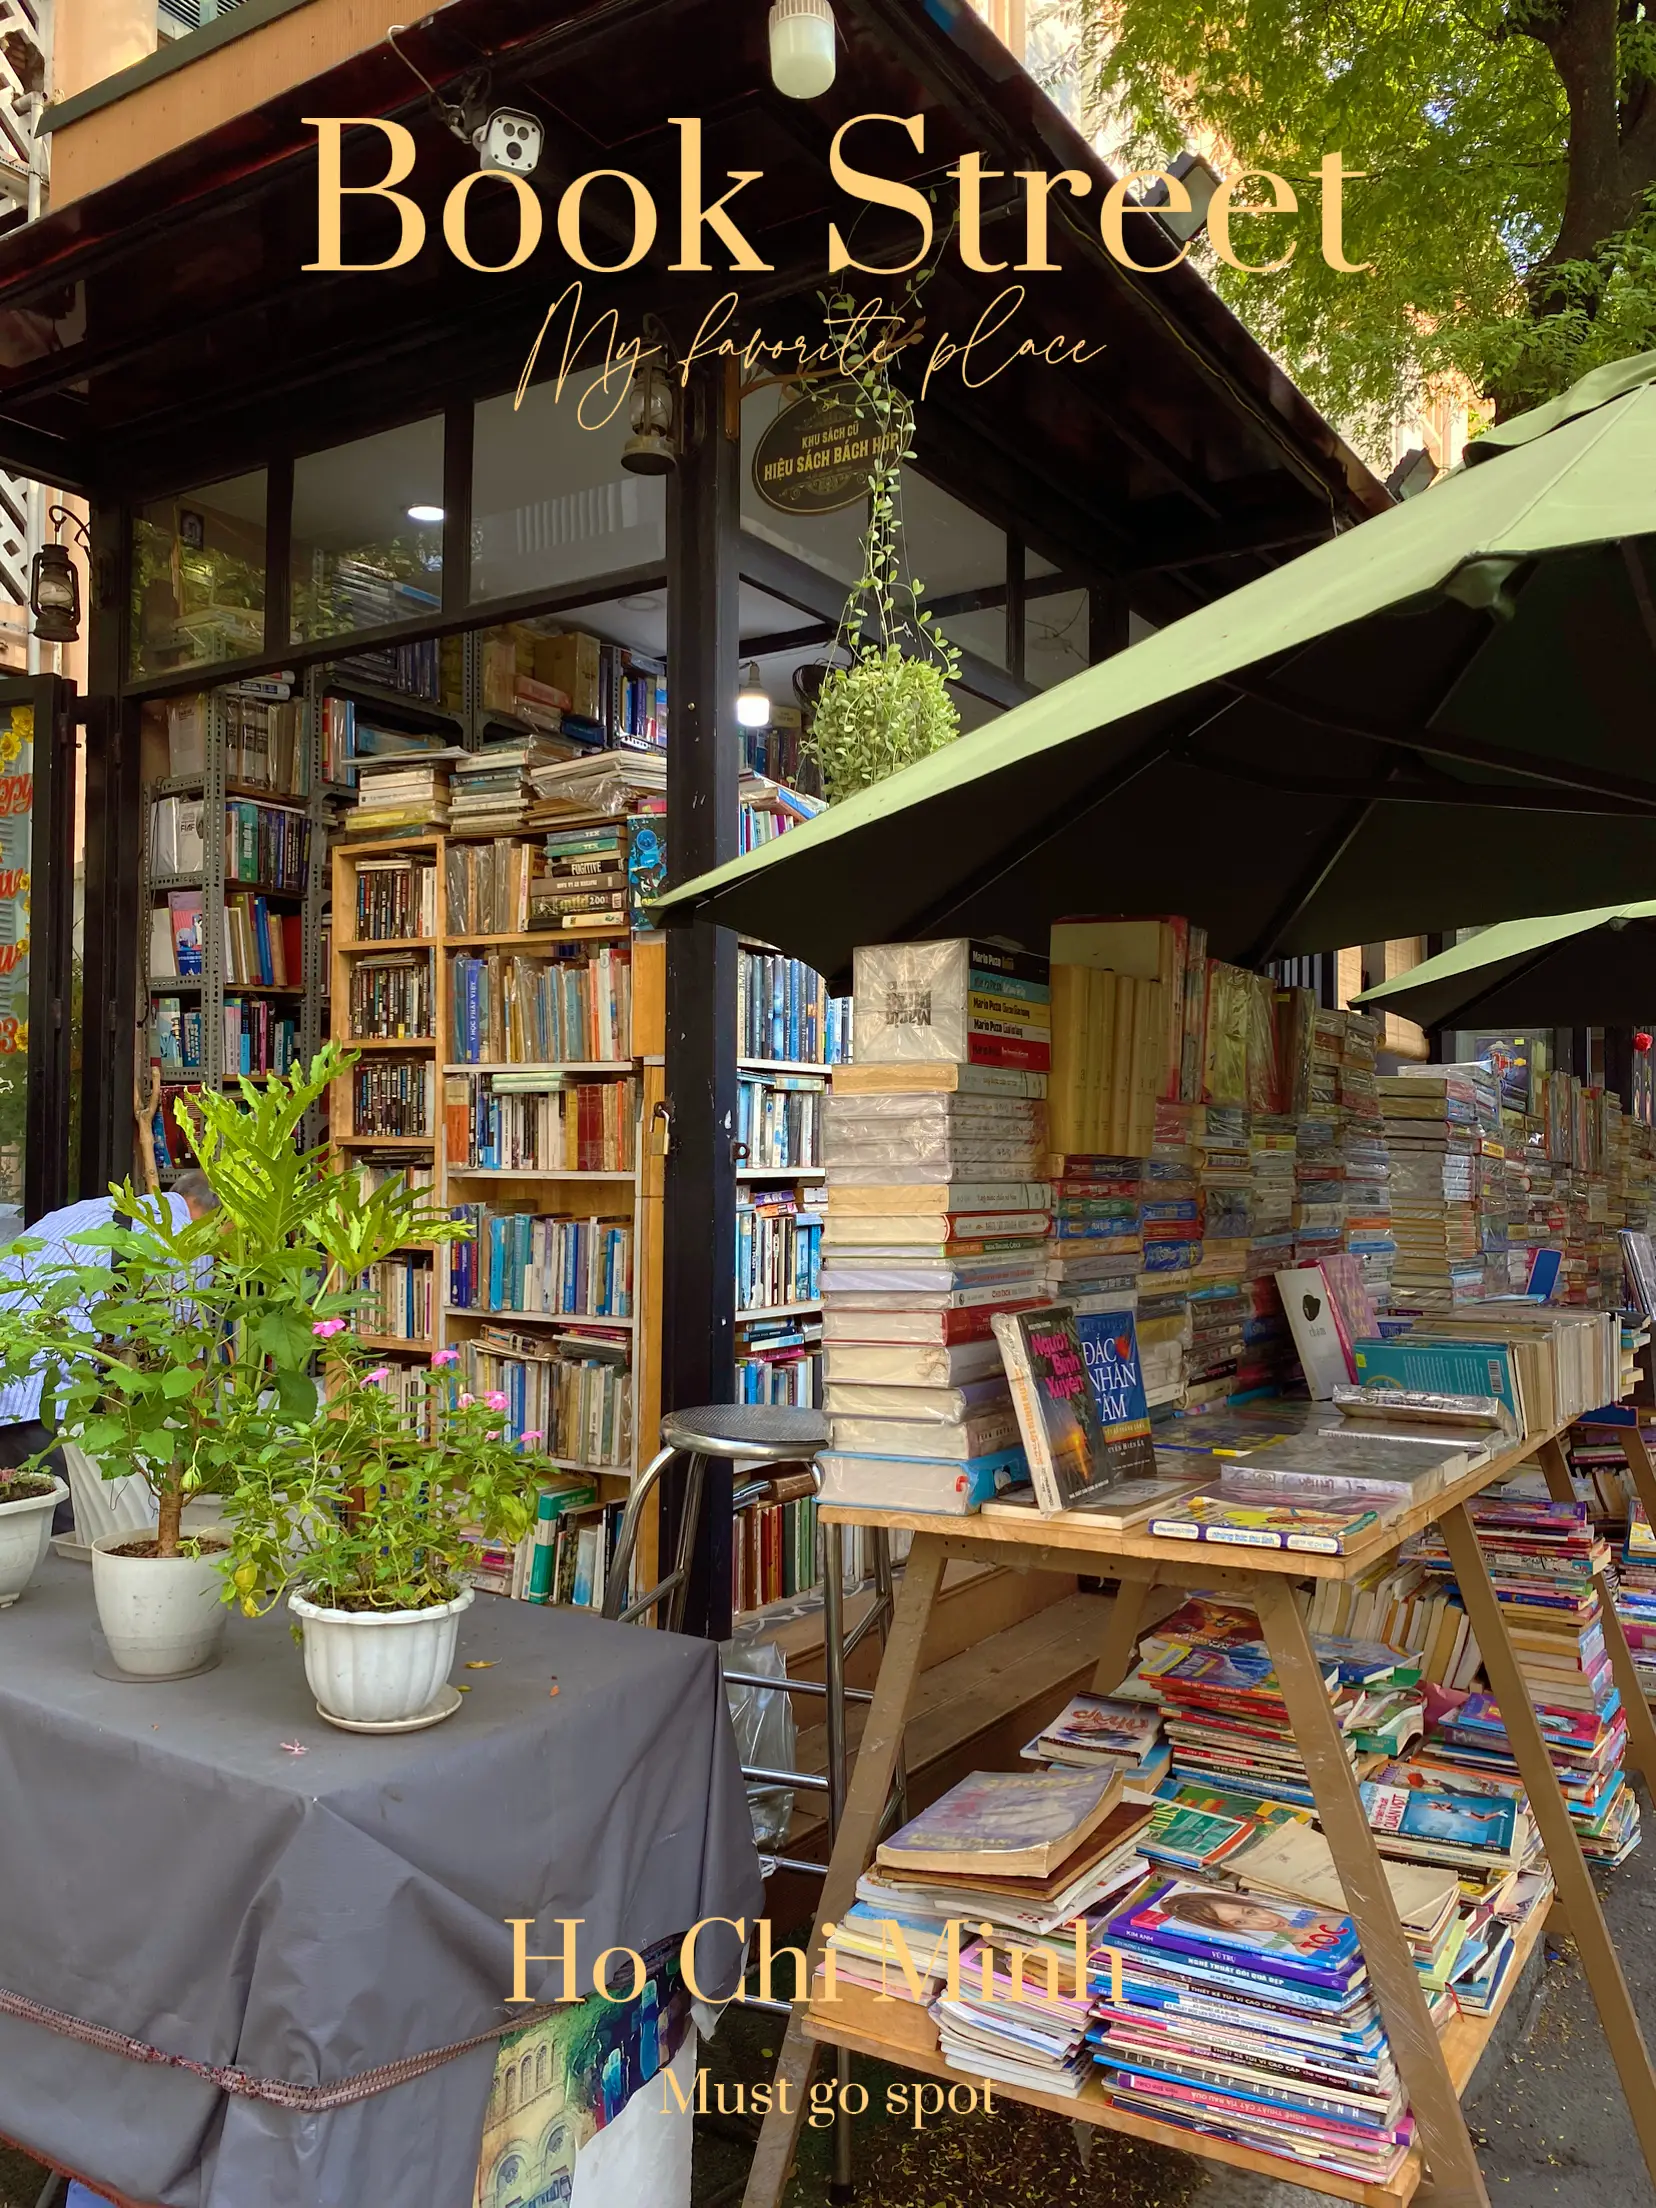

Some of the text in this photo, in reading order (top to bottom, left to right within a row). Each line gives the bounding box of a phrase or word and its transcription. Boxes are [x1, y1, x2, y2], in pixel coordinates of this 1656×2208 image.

[801, 432, 820, 449] KHU
[822, 427, 845, 443] SÁCH
[764, 458, 794, 482] HIỆU
[797, 448, 830, 473] SÁCH
[833, 439, 868, 463] BÁCH
[571, 862, 601, 875] FUGITIVE
[973, 951, 988, 965] Mario
[973, 997, 988, 1010] Mario
[989, 1001, 1002, 1013] Puzo
[974, 1019, 989, 1030] Mario
[990, 1021, 1002, 1032] Puzo
[1081, 1333, 1117, 1366] ĐẮC
[1126, 1930, 1138, 1938] KIM
[1139, 1932, 1154, 1941] ANH
[1210, 1961, 1234, 1974] THUẬT
[1245, 1998, 1260, 2007] CAO
[1268, 2060, 1284, 2069] CAO
[1252, 2084, 1288, 2100] HOA
